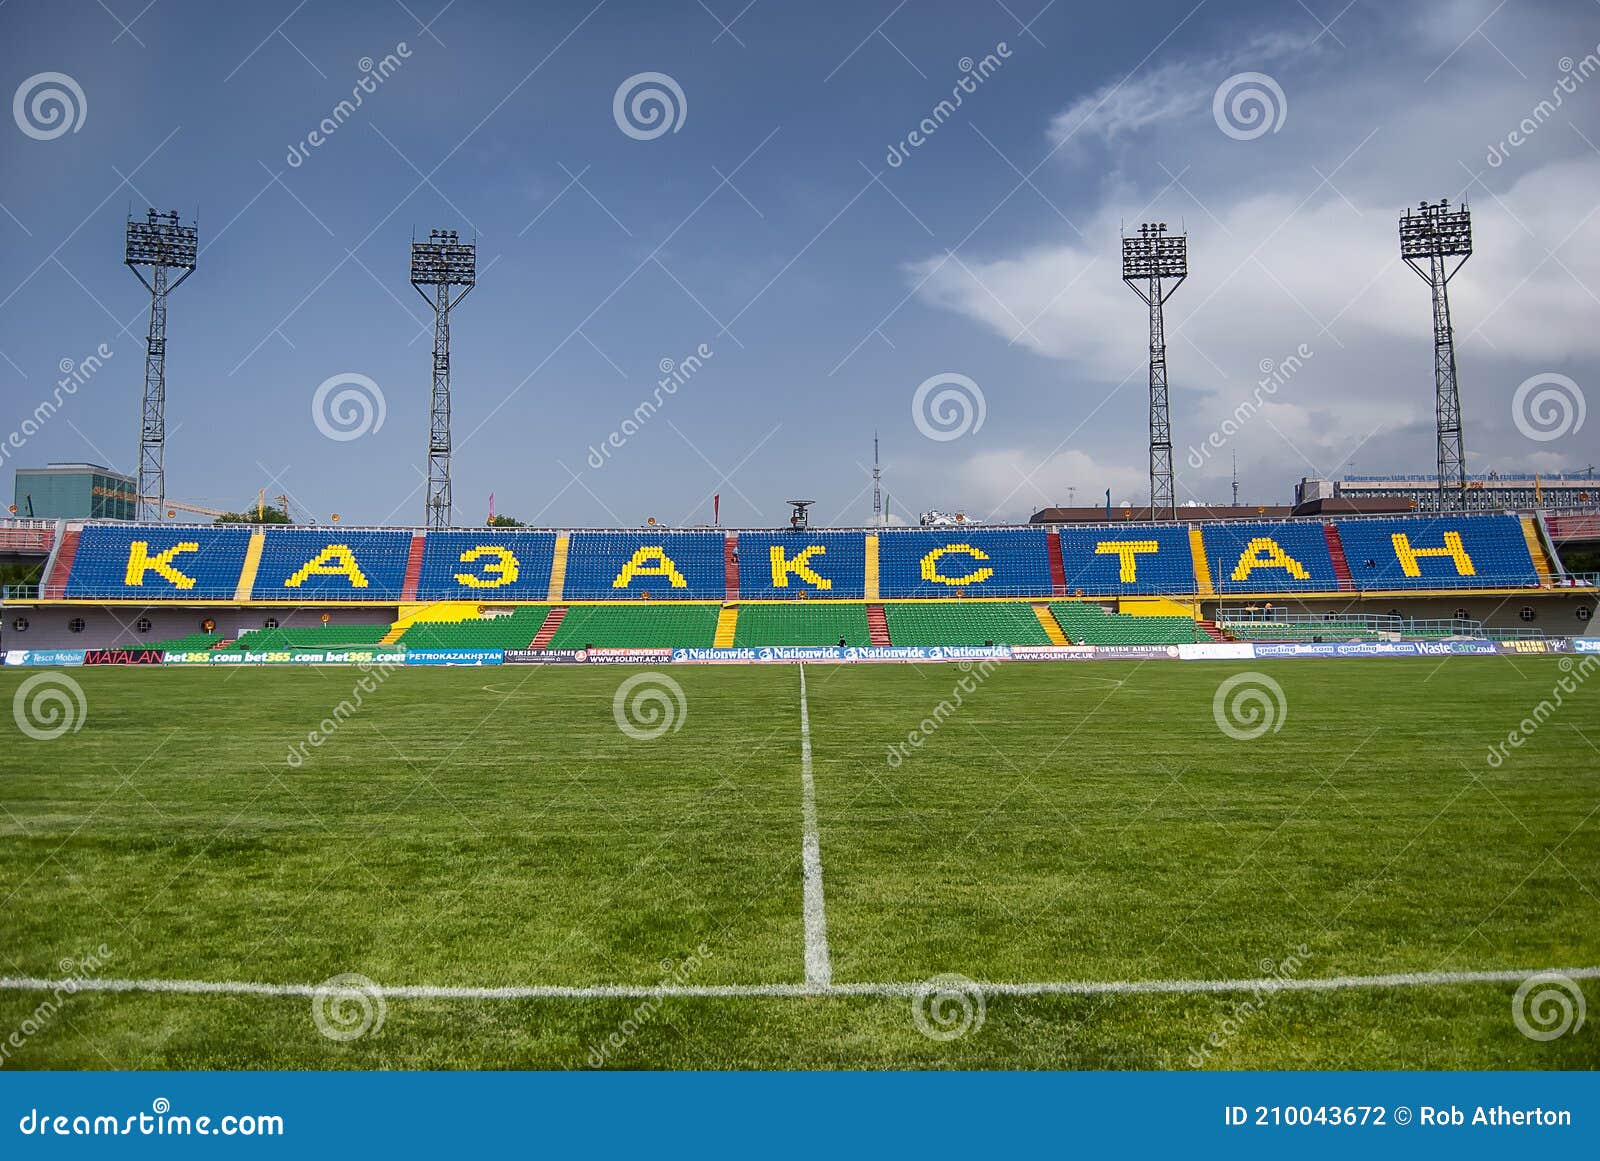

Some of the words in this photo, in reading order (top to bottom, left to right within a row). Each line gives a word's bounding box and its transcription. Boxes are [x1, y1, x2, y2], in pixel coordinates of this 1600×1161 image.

[33, 653, 53, 662] Tesco
[54, 653, 82, 662] Mobile
[84, 650, 165, 665] MATALAN
[164, 652, 242, 663] bet365.com
[245, 652, 323, 662] bet365.com
[326, 652, 406, 662] bet365.com
[408, 652, 502, 661] PETROKAZAKHSTAN
[689, 648, 755, 659] Nationwide
[774, 648, 840, 659] Nationwide
[858, 647, 925, 658] Nationwide
[943, 646, 1010, 658] Nationwide
